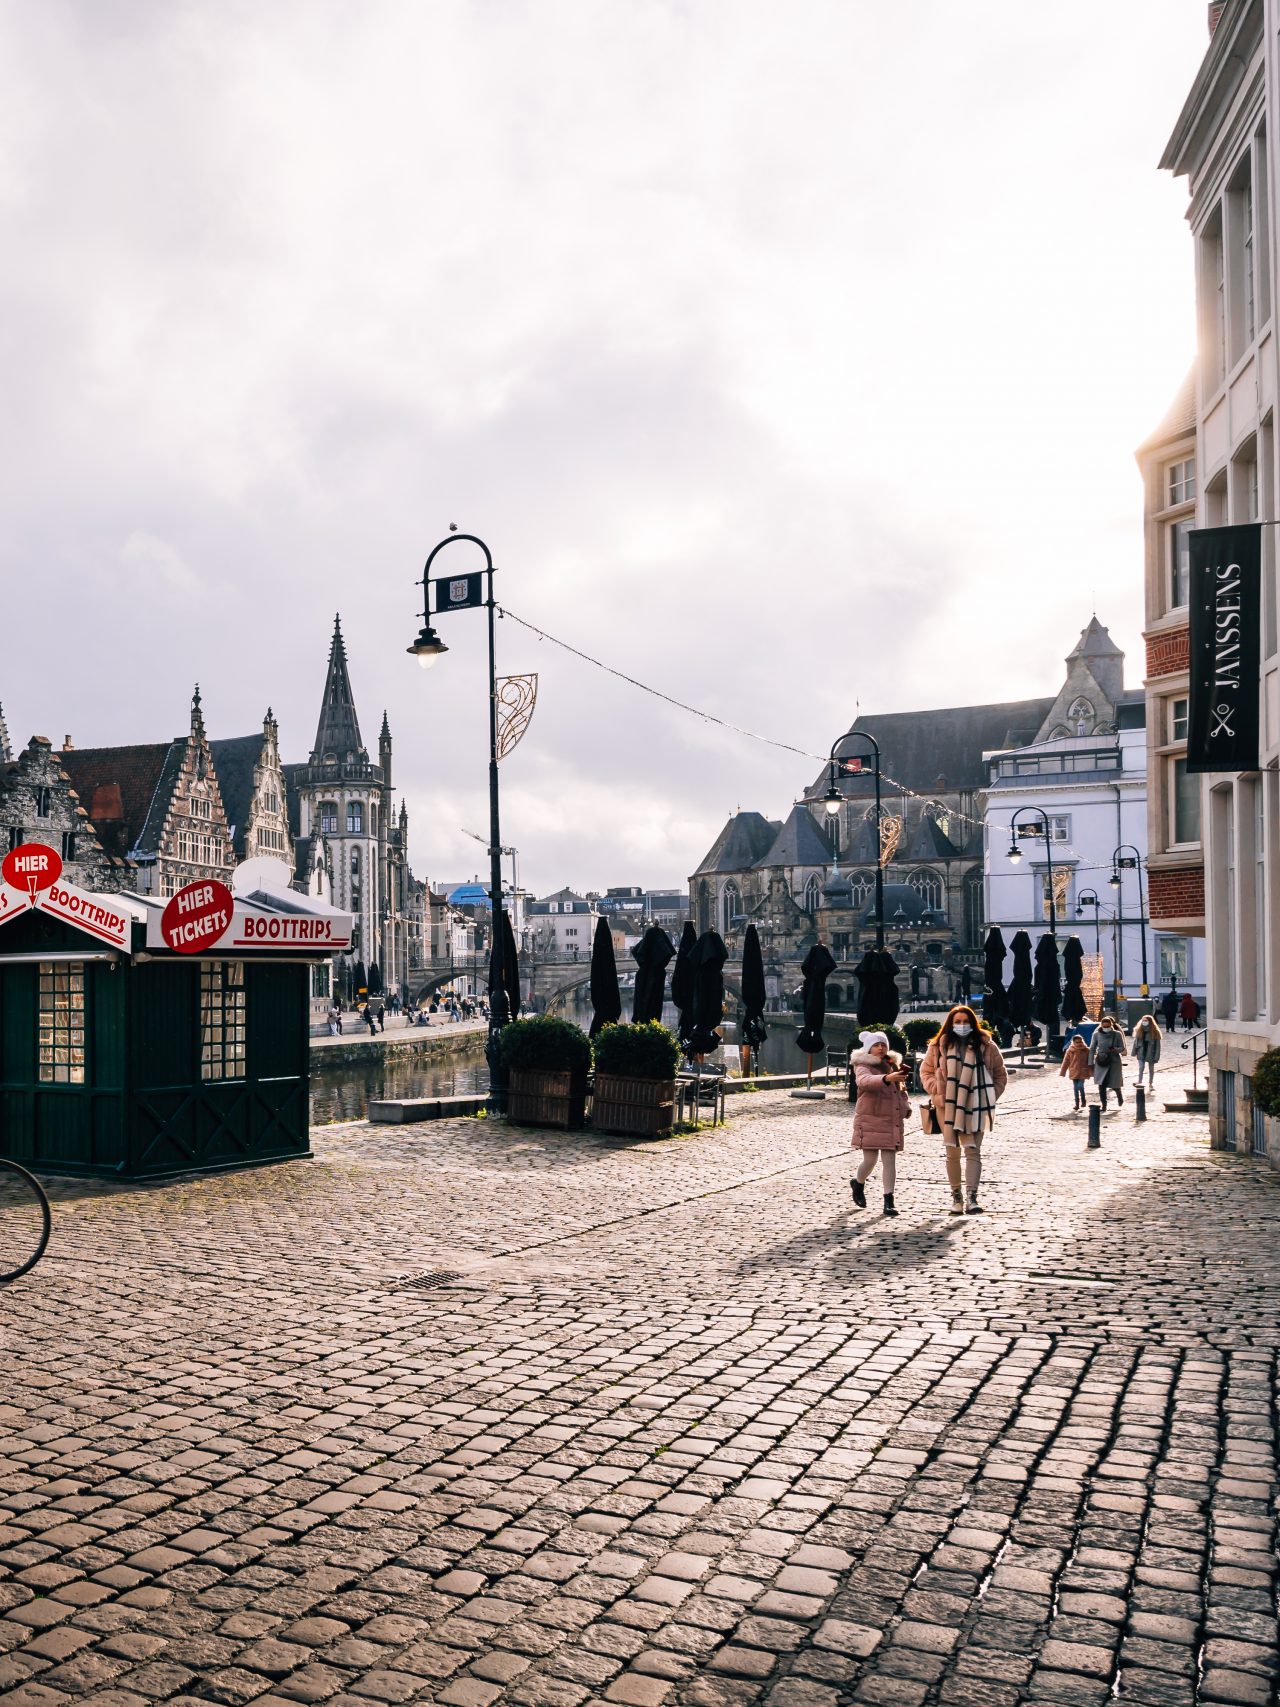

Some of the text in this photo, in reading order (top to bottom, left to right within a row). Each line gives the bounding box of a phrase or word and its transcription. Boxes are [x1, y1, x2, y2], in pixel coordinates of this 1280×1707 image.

[1215, 563, 1241, 689] JANSSENS
[14, 855, 49, 873] HIER
[48, 885, 126, 934] BOOTTRIPS
[177, 885, 214, 915] HIER
[170, 909, 228, 947] TICKETS
[244, 917, 332, 940] BOOTTRIPS
